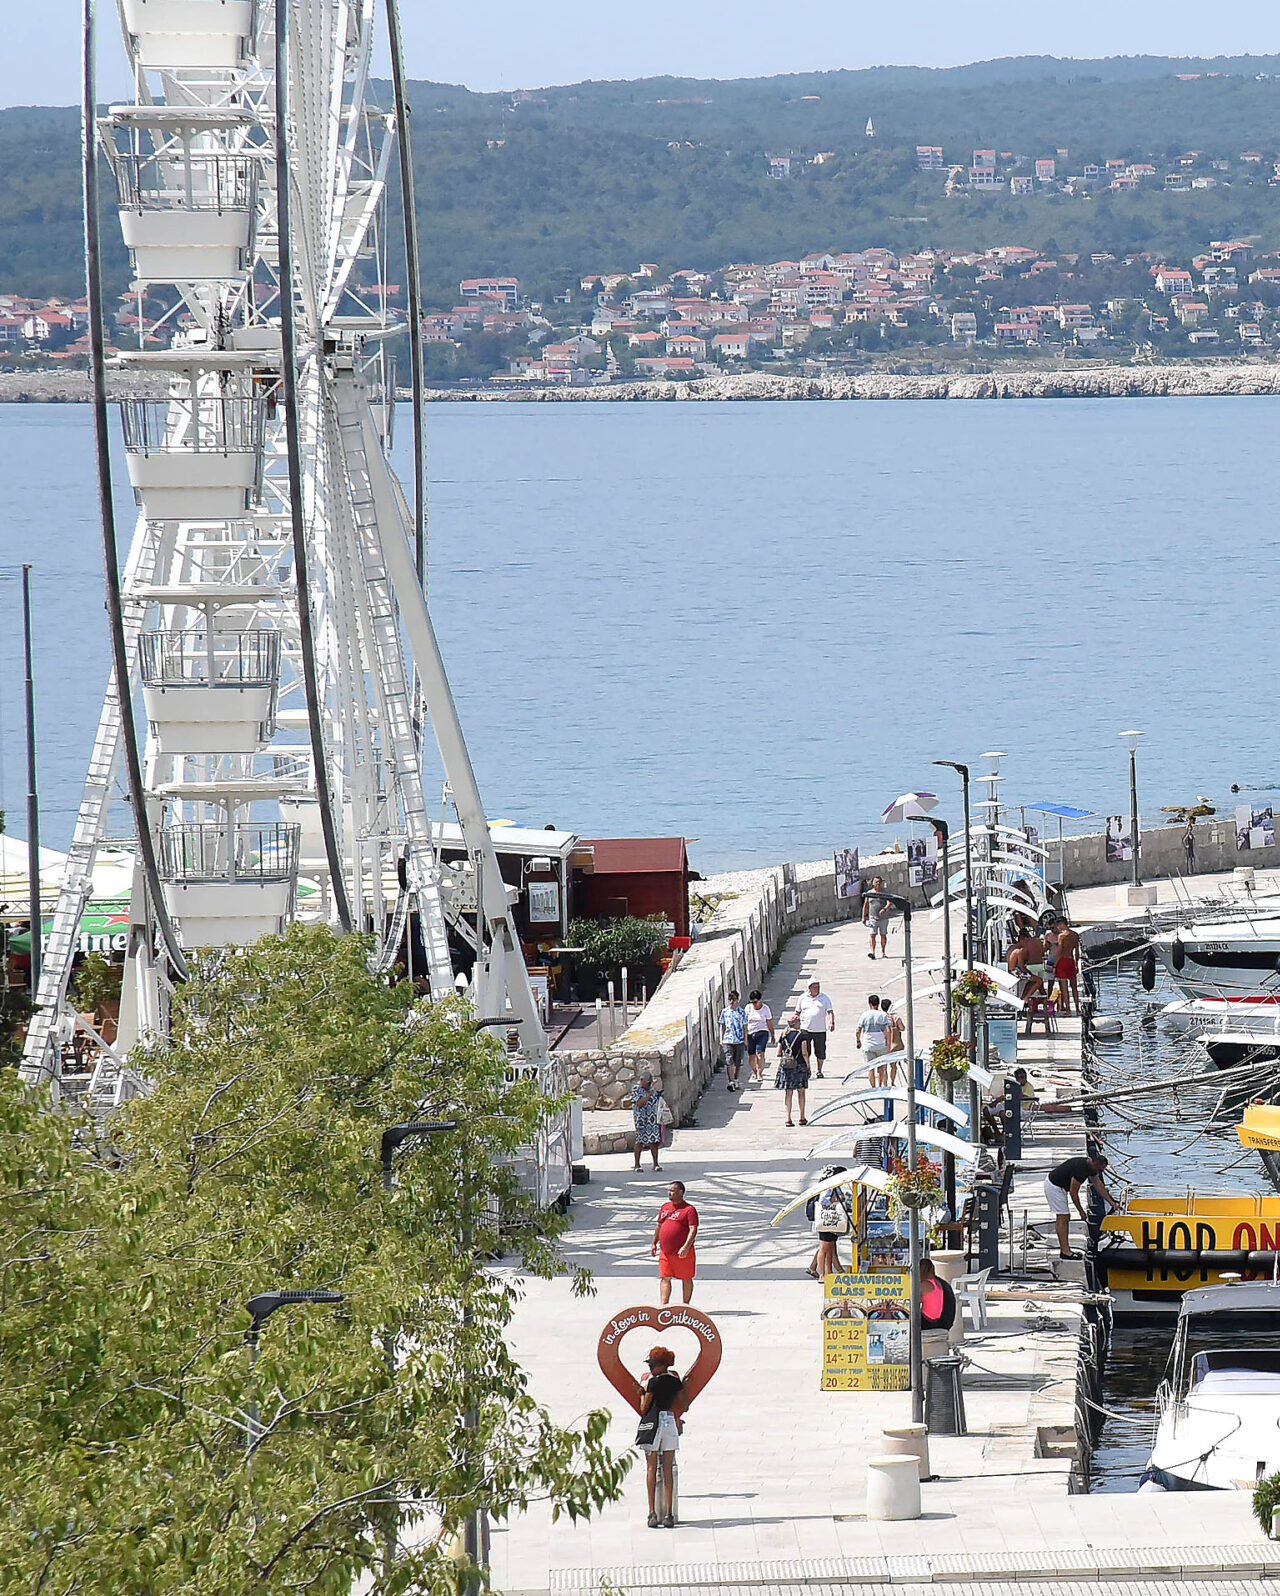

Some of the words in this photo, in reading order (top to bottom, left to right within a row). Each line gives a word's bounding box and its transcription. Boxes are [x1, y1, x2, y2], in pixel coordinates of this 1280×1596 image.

[1141, 1220, 1217, 1283] HOP
[831, 1287, 865, 1296] GLASS
[874, 1287, 903, 1296] BOAT
[834, 1275, 902, 1286] AQUAVISION
[602, 1333, 616, 1345] in
[610, 1315, 638, 1335] Love
[638, 1310, 651, 1321] in
[657, 1309, 716, 1343] Crikvenica
